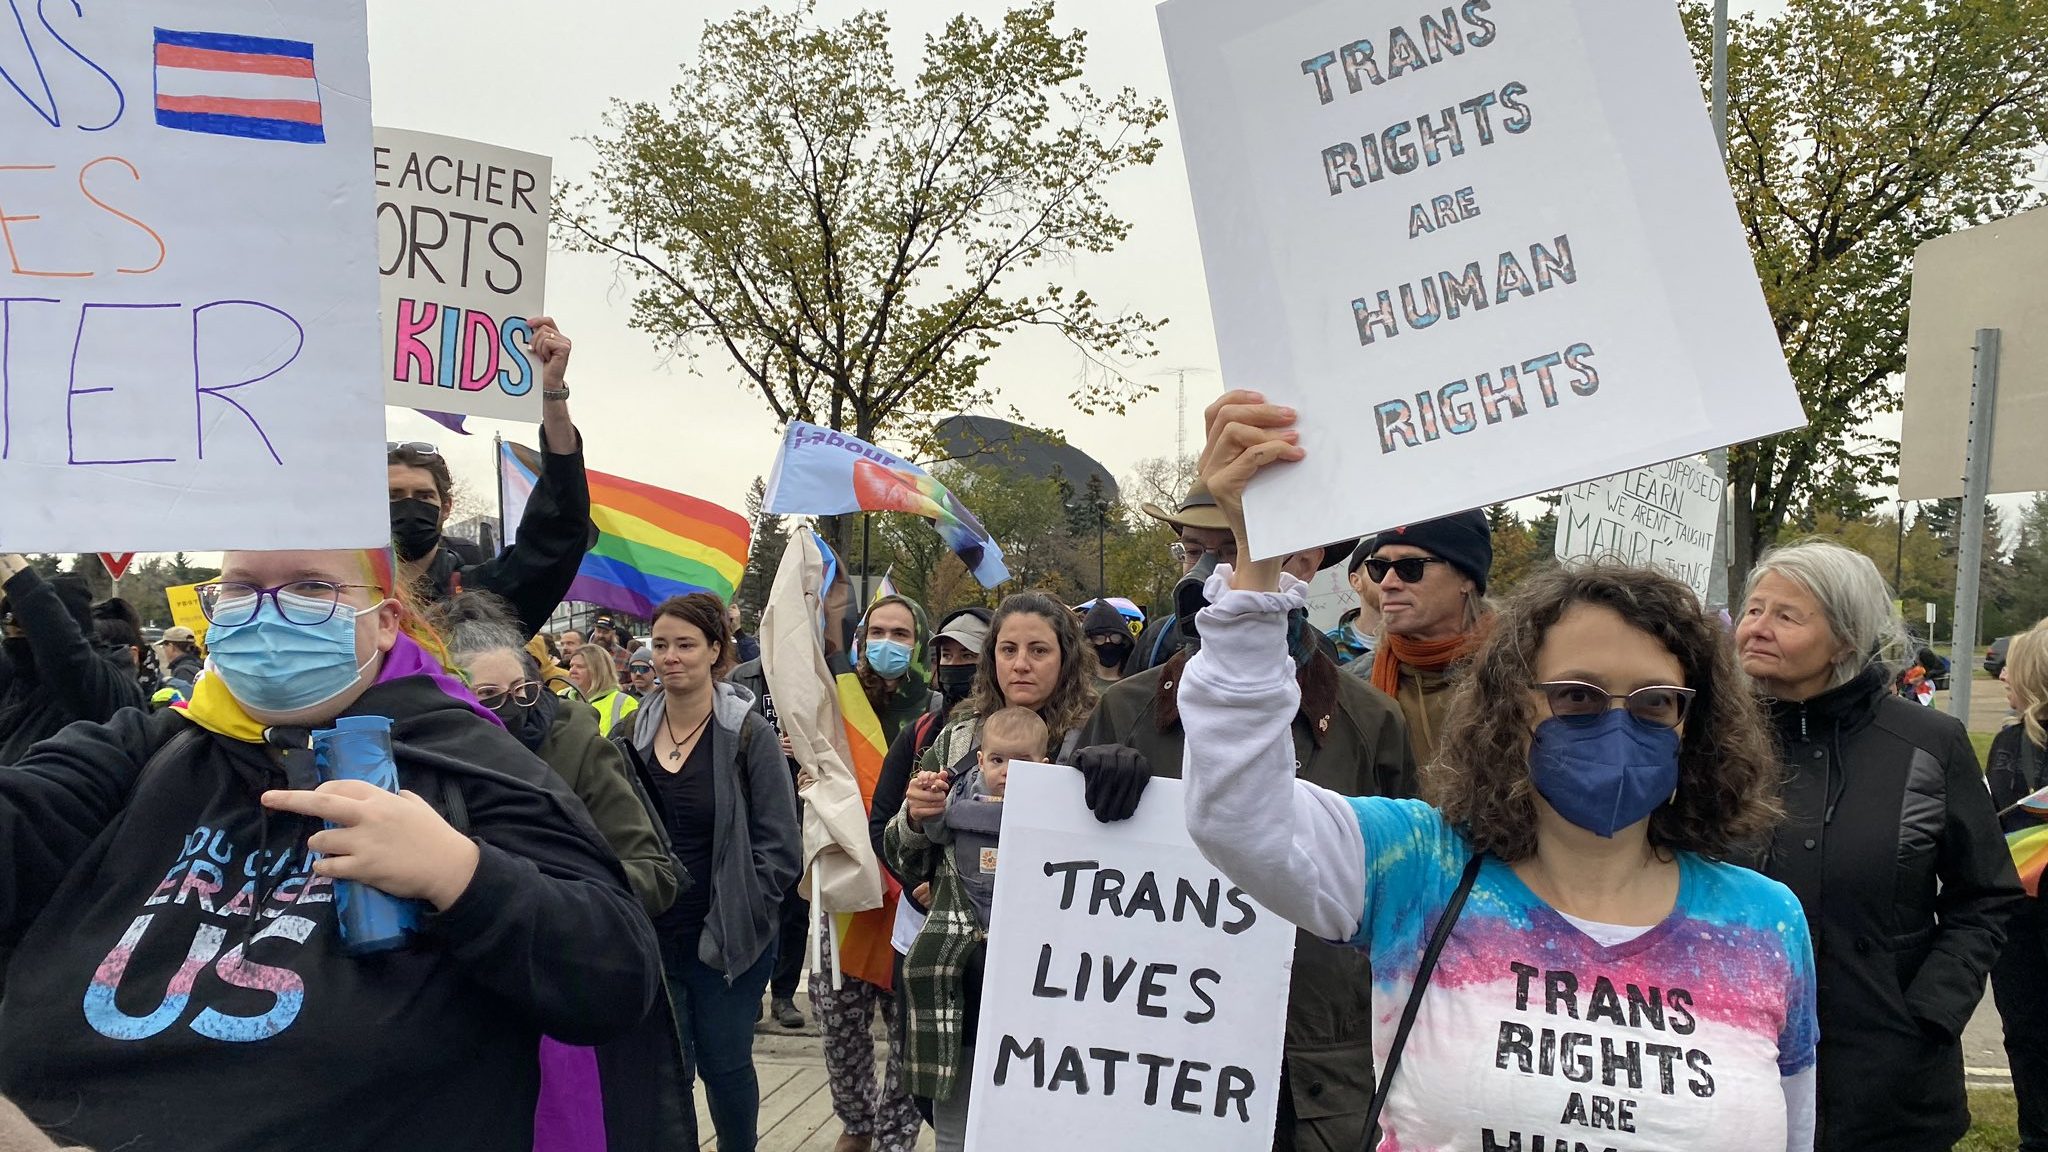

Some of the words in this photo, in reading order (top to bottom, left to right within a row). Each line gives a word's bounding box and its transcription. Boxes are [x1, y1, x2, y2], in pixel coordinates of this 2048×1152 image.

[1300, 0, 1498, 106] TRANS
[1321, 81, 1533, 196] RIGHTS
[1408, 186, 1481, 240] ARE
[1351, 234, 1577, 346] HUMAN
[394, 298, 534, 398] KIDS
[1373, 342, 1600, 455] RIGHTS
[1607, 490, 1628, 516] WE
[1675, 520, 1714, 551] TAUGHT
[1624, 471, 1685, 515] LEARN
[144, 859, 333, 921] ERASE
[1043, 859, 1259, 935] TRANS
[83, 913, 317, 1043] US
[1031, 943, 1222, 1025] LIVES
[1510, 961, 1697, 1036] TRANS
[993, 1034, 1257, 1124] MATTER
[1495, 1021, 1715, 1098] RIGHTS
[1560, 1092, 1638, 1133] ARE
